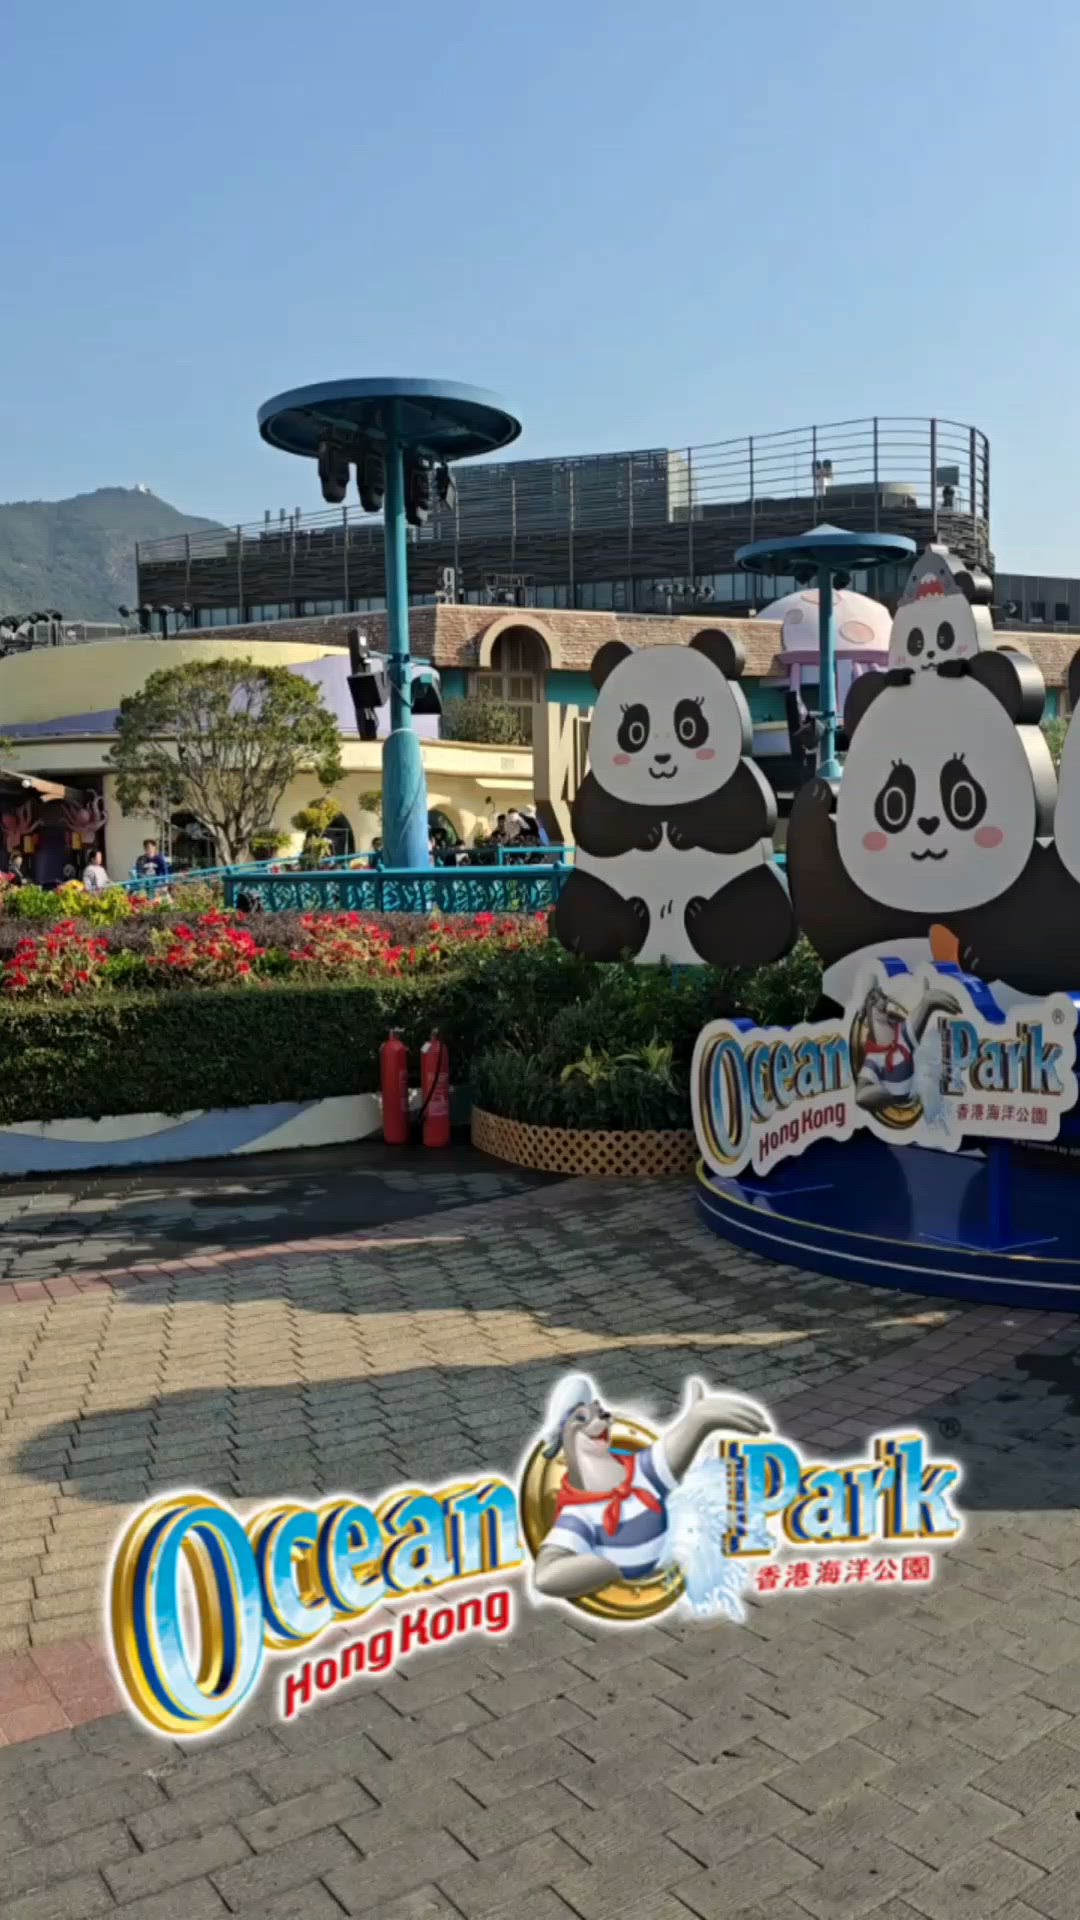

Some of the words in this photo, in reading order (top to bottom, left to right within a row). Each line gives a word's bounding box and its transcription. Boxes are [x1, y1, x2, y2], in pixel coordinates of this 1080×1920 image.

[701, 1031, 850, 1165] Ocean
[938, 1016, 1064, 1096] Park
[956, 1103, 1048, 1125] 香港海洋公園
[758, 1118, 800, 1162] Hong
[801, 1102, 846, 1134] Kong
